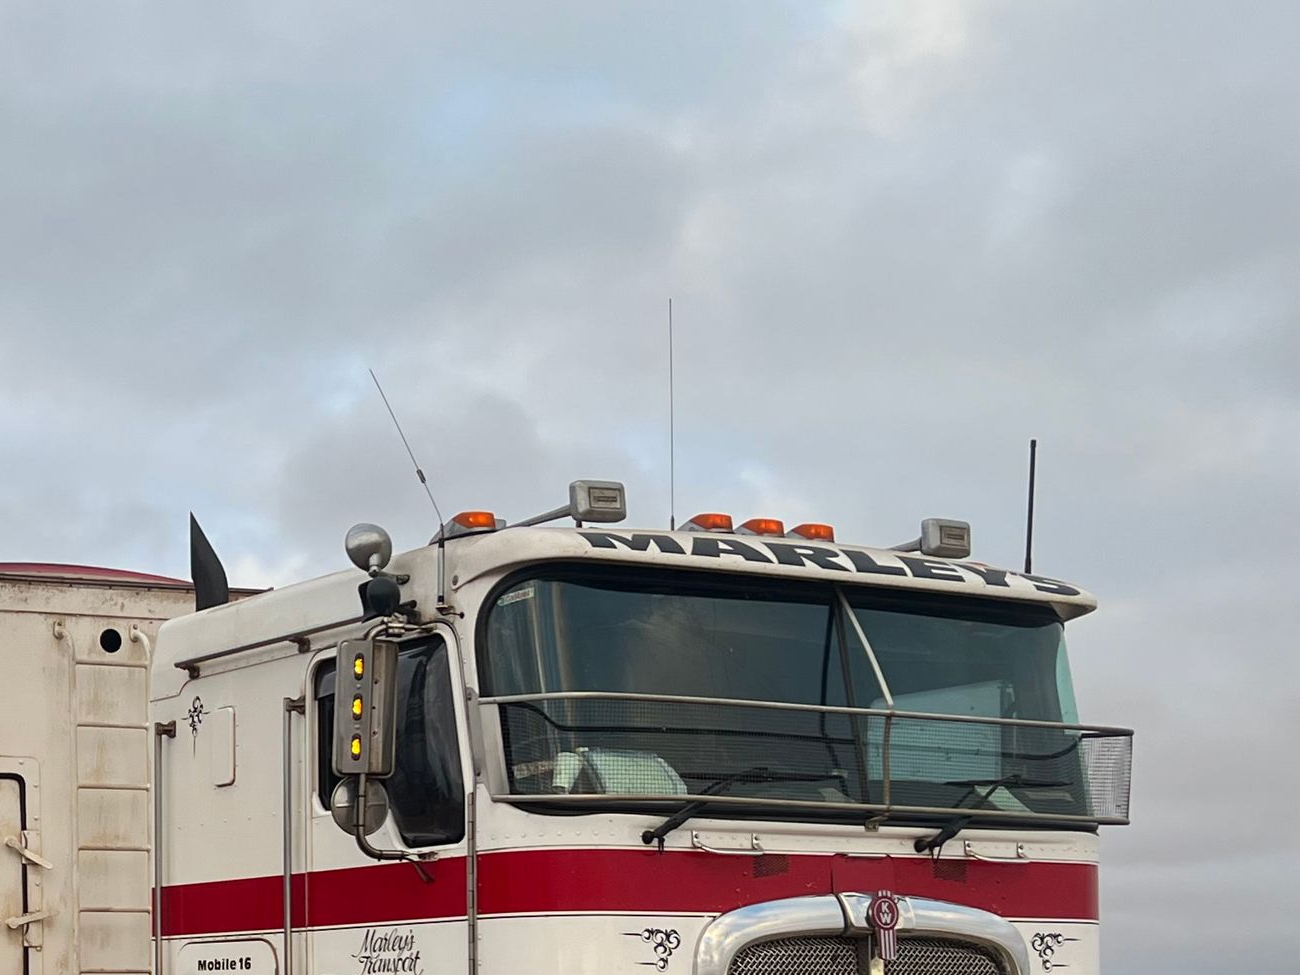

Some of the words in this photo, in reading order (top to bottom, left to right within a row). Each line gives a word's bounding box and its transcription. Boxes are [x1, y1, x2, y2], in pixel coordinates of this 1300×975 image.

[351, 928, 416, 958] Marley's
[198, 958, 237, 971] Mobile
[239, 957, 251, 970] 16
